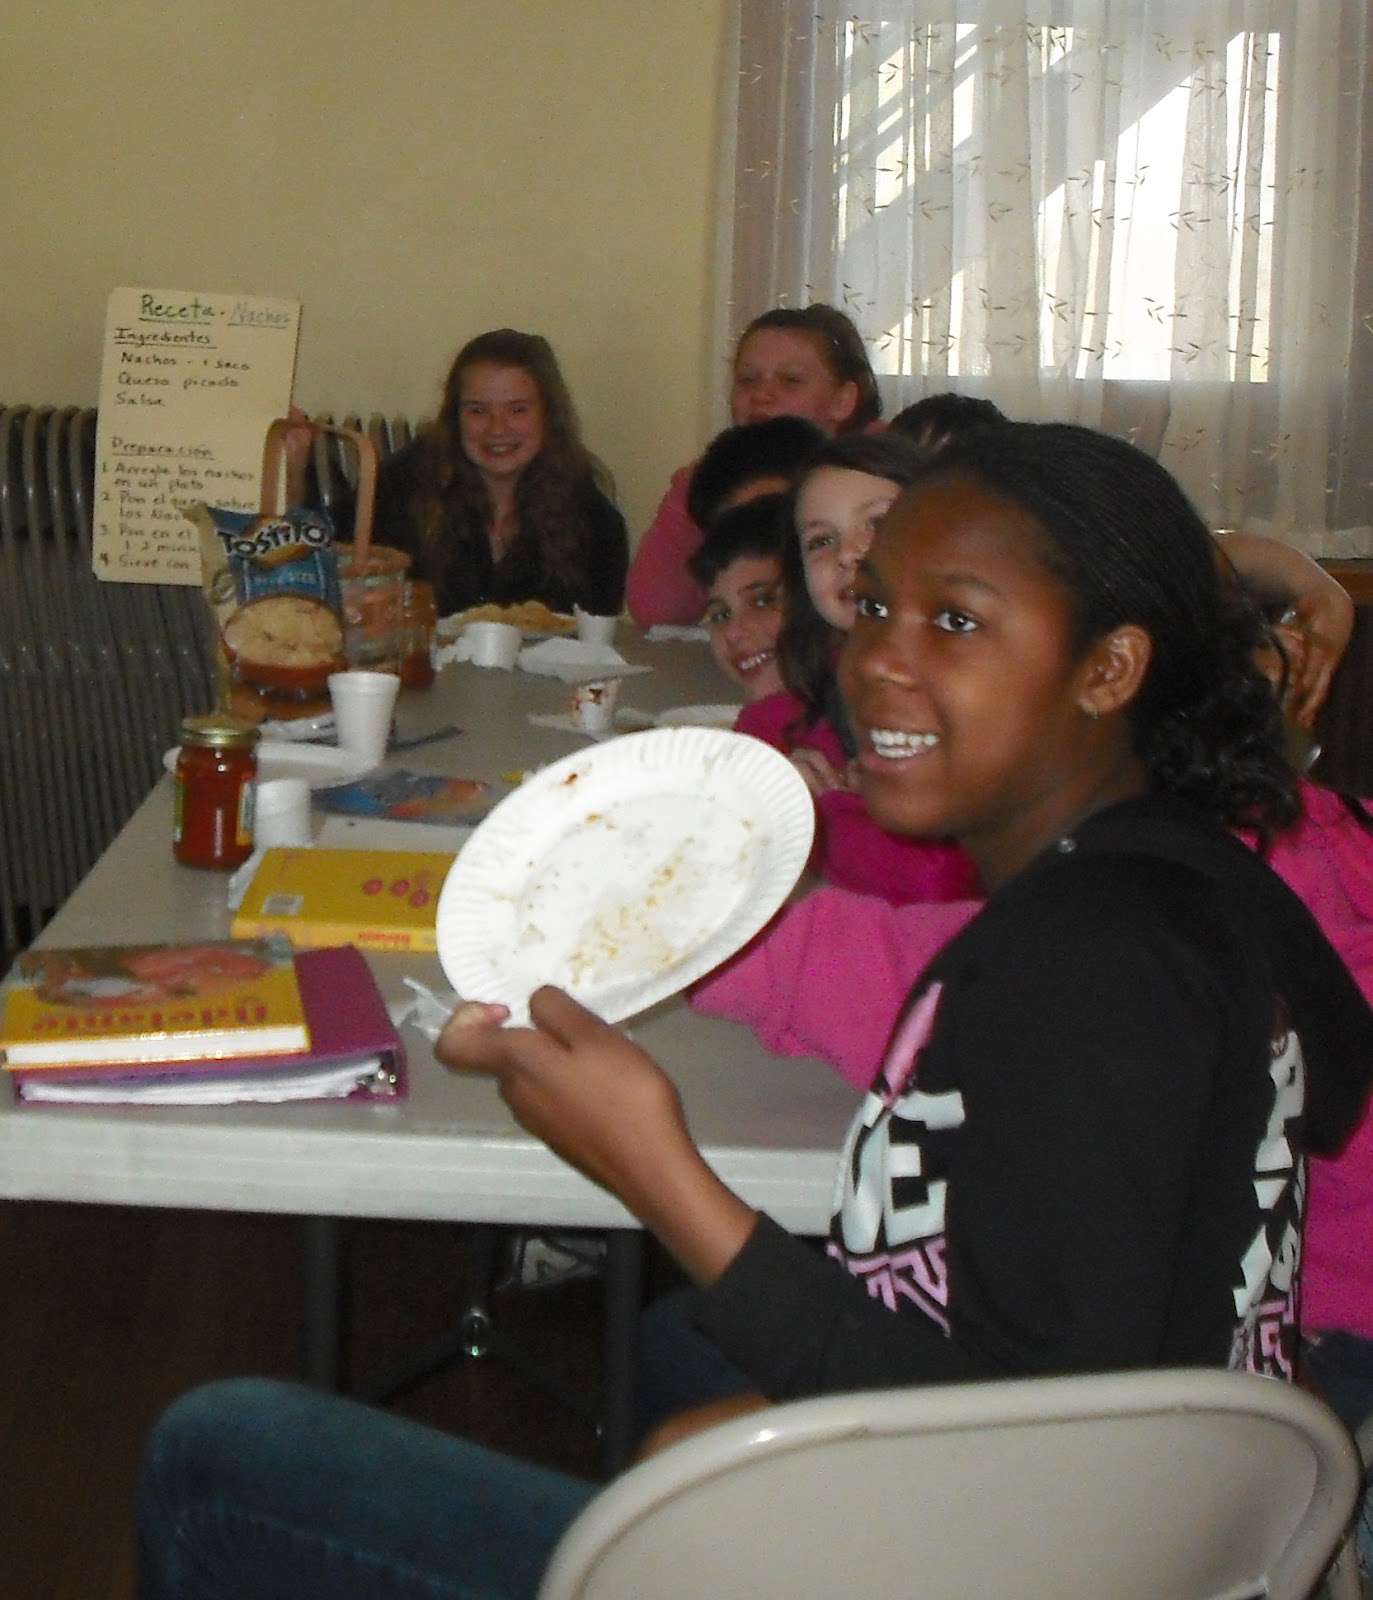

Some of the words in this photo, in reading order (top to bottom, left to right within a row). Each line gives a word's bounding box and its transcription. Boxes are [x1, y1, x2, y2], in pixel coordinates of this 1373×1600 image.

[141, 294, 216, 318] Receta
[229, 302, 290, 323] Nachos
[113, 327, 211, 348] Ingredientes
[121, 351, 177, 366] Nachos
[118, 371, 170, 387] Queso
[183, 375, 240, 390] picado
[115, 392, 166, 406] Salsa
[178, 464, 199, 477] los
[138, 479, 158, 488] un
[153, 494, 166, 504] el
